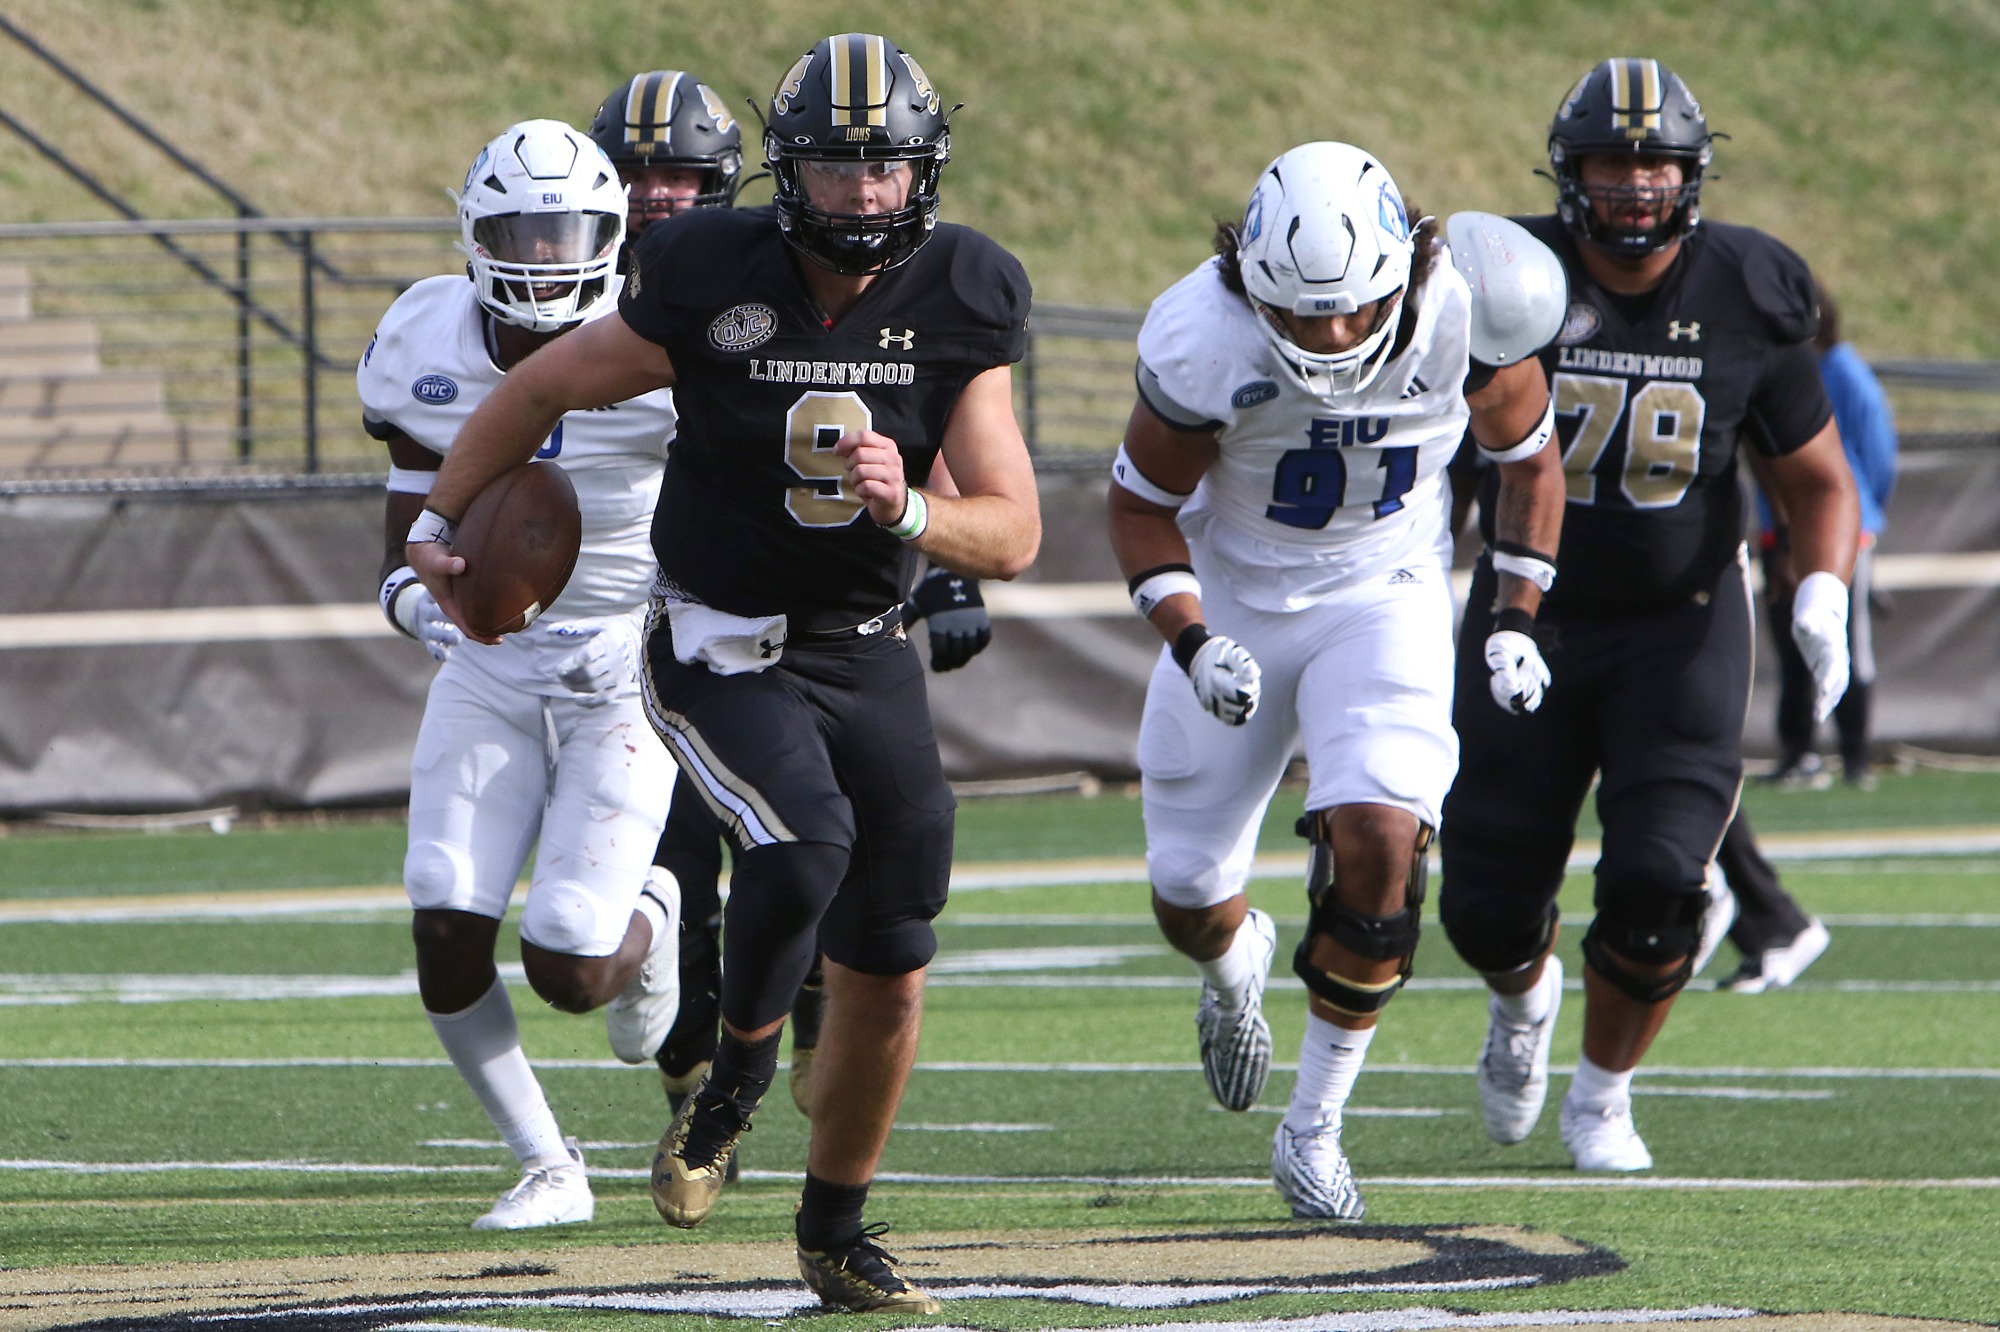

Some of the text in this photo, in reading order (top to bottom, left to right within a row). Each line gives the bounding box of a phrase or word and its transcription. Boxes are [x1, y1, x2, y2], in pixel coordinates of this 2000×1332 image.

[846, 127, 871, 142] LIONS
[542, 193, 563, 204] EIU
[1315, 300, 1336, 311] EIU
[722, 312, 764, 342] OVC
[749, 359, 916, 385] LINDENWOOD
[1558, 347, 1703, 379] LINDENWOOD
[421, 383, 447, 397] OVC
[1306, 416, 1390, 450] EIU
[1552, 371, 1706, 508] 78
[784, 390, 873, 528] 9
[1265, 446, 1420, 530] 91
